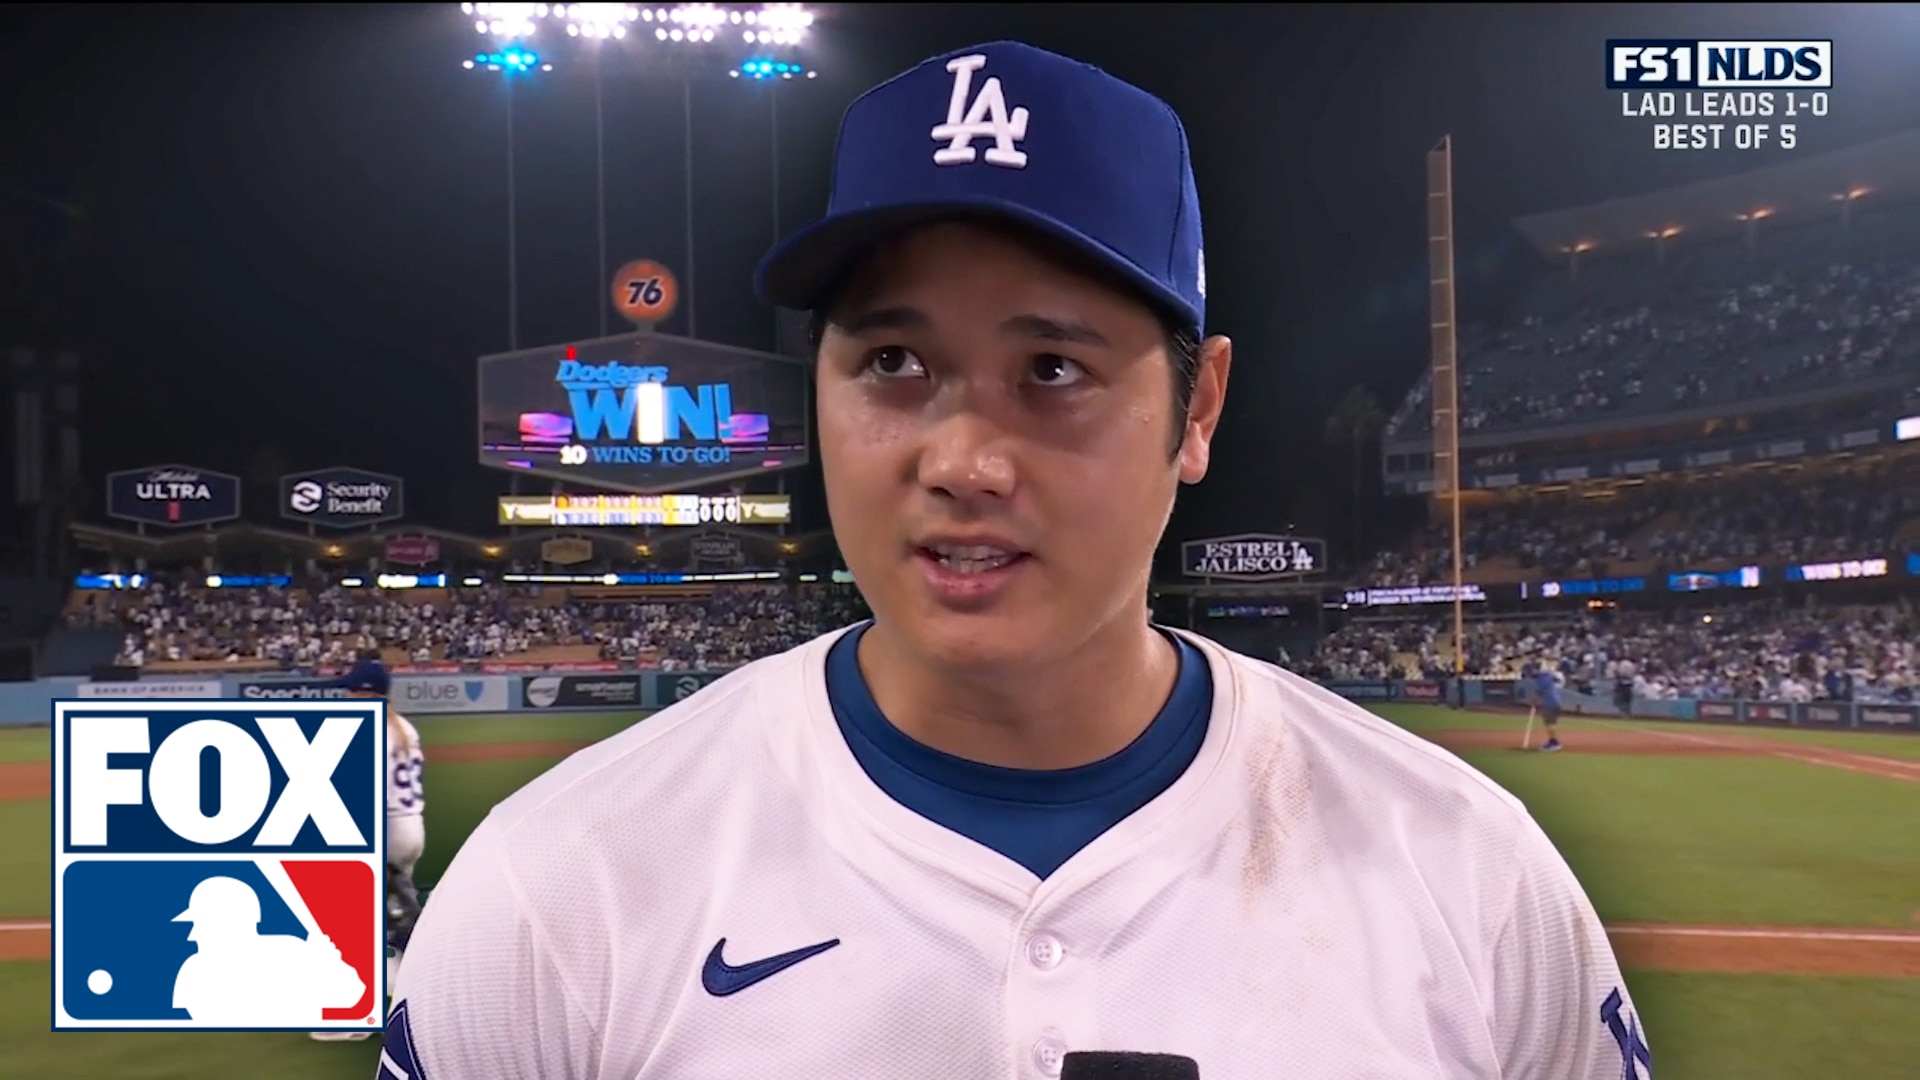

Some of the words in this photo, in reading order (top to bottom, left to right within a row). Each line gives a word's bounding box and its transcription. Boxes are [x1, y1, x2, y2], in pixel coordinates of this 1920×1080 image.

[930, 53, 1030, 169] LA
[626, 277, 667, 308] 76
[555, 360, 670, 389] Dodgers
[568, 382, 733, 444] WIN!
[560, 445, 588, 465] 10
[592, 446, 653, 464] WINS
[656, 446, 688, 463] TO
[693, 446, 731, 463] GO!
[135, 483, 212, 500] ULTRA
[327, 482, 392, 501] Security
[327, 498, 383, 514] Benefit
[1195, 557, 1288, 573] JALISCO
[406, 681, 459, 700] blue
